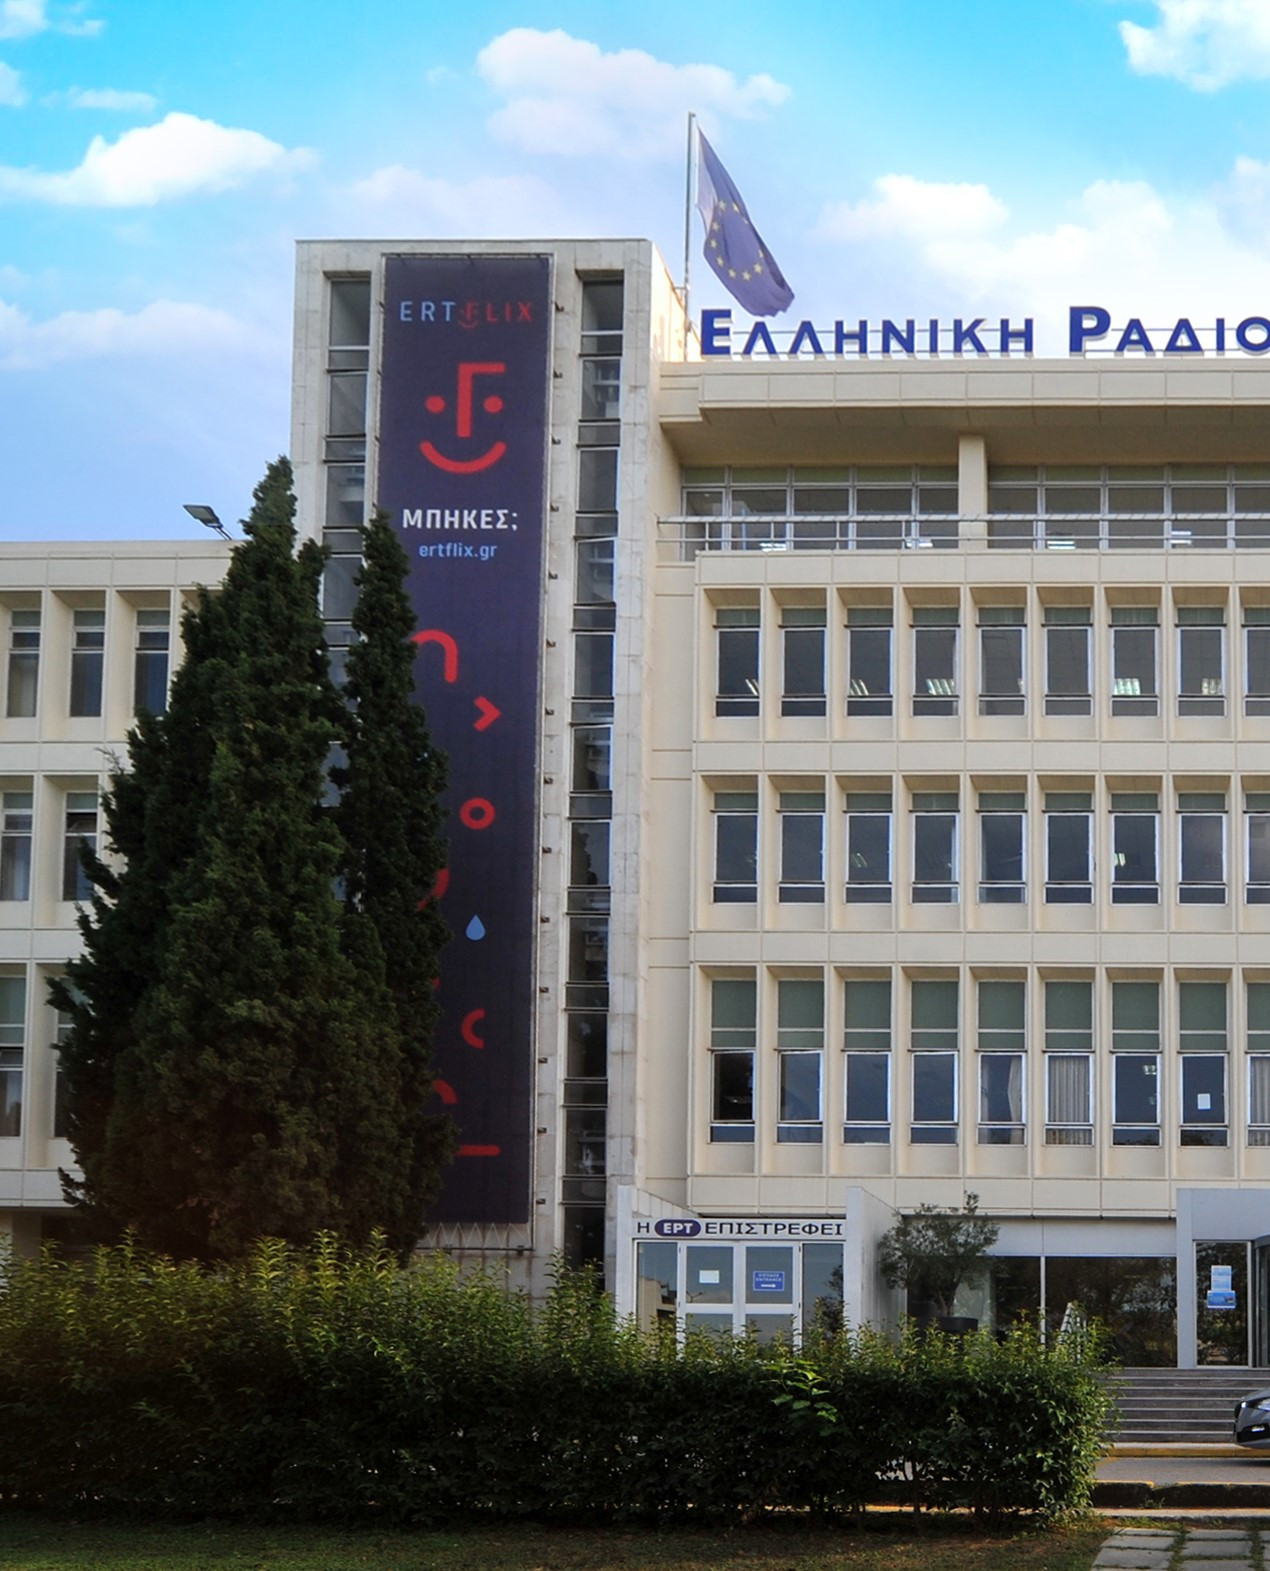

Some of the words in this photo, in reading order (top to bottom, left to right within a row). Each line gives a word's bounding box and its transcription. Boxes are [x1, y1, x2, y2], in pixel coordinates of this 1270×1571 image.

[701, 309, 1034, 355] ΕΛΛΗΝΙΚΗ
[403, 509, 518, 531] ΜΠΗΚΕΣ;
[418, 541, 499, 560] ertflix.gr
[637, 1222, 650, 1234] Η
[662, 1222, 694, 1234] ΕΡΤ
[704, 1222, 844, 1236] ΕΠΙΣΤΡΕΦΕΙ
